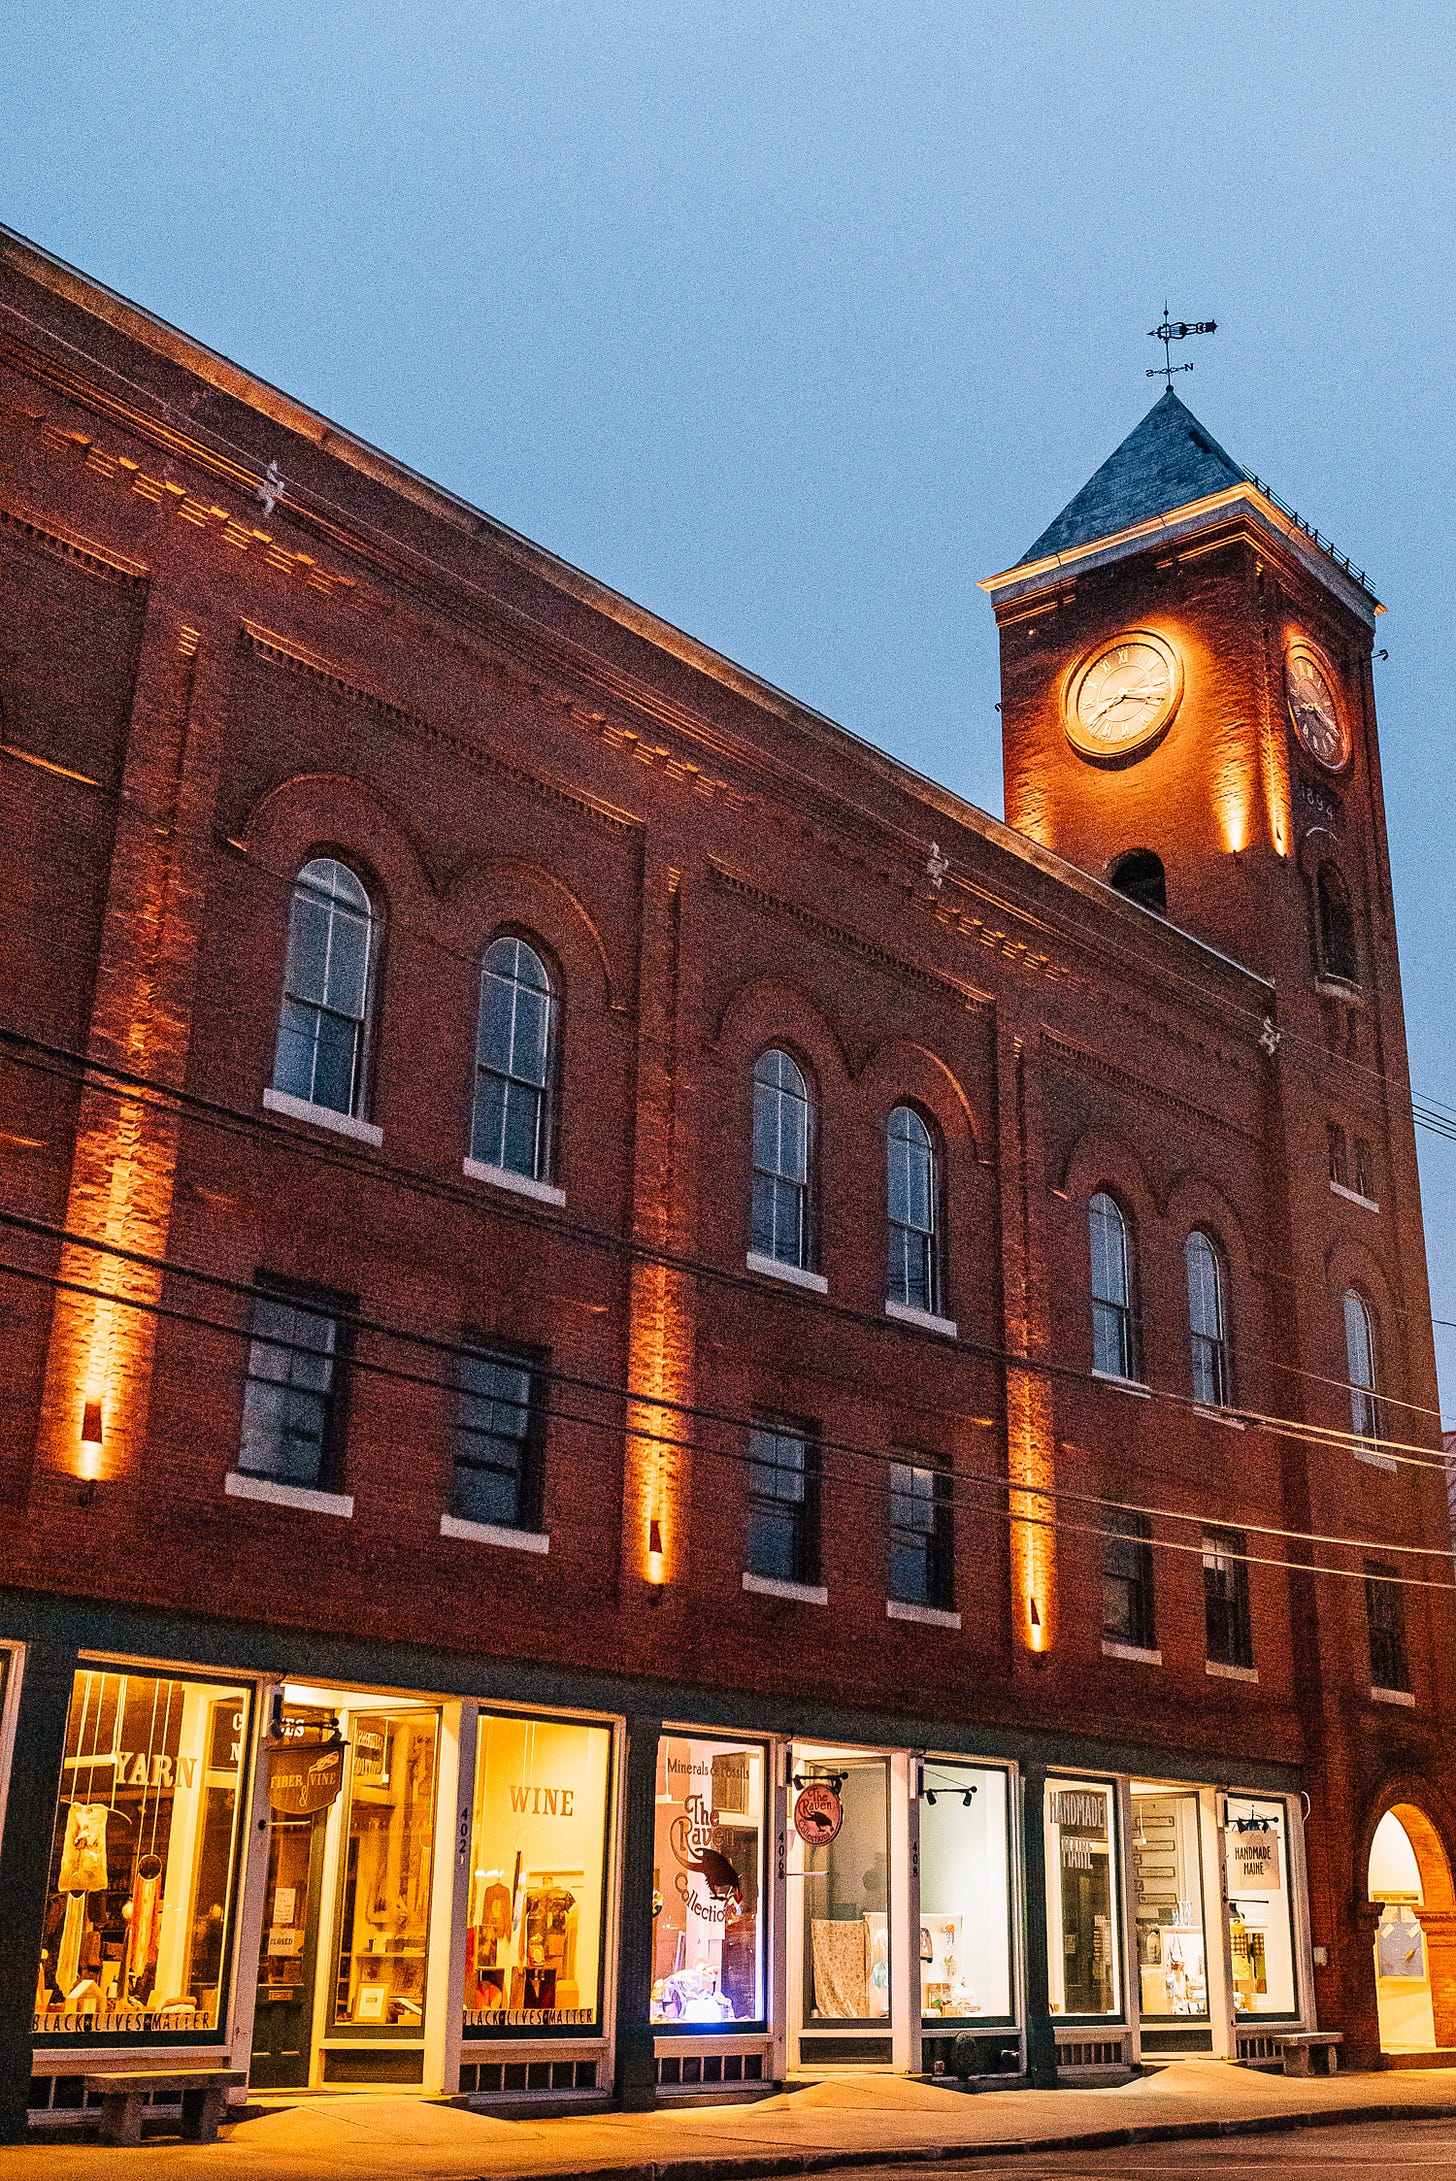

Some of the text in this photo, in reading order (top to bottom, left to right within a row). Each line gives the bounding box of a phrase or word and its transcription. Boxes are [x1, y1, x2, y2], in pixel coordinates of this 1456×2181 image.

[116, 1751, 198, 1789] YARN
[667, 1757, 708, 1776] Minerals
[269, 1774, 303, 1790] FIBER
[310, 1773, 337, 1786] VINE
[508, 1785, 574, 1817] WINE
[807, 1788, 828, 1802] The
[684, 1793, 720, 1826] The
[798, 1799, 832, 1813] Raven
[1049, 1790, 1104, 1828] HANDMADE
[460, 1807, 468, 1853] 402
[670, 1816, 735, 1853] Raven
[1235, 1846, 1271, 1860] HANDMADE
[1243, 1861, 1265, 1876] MAINE
[270, 1937, 293, 1946] CLOSED
[33, 2011, 209, 2032] BLACK LIVES MATTER
[463, 2008, 593, 2026] BLACK LIVES MATTER
